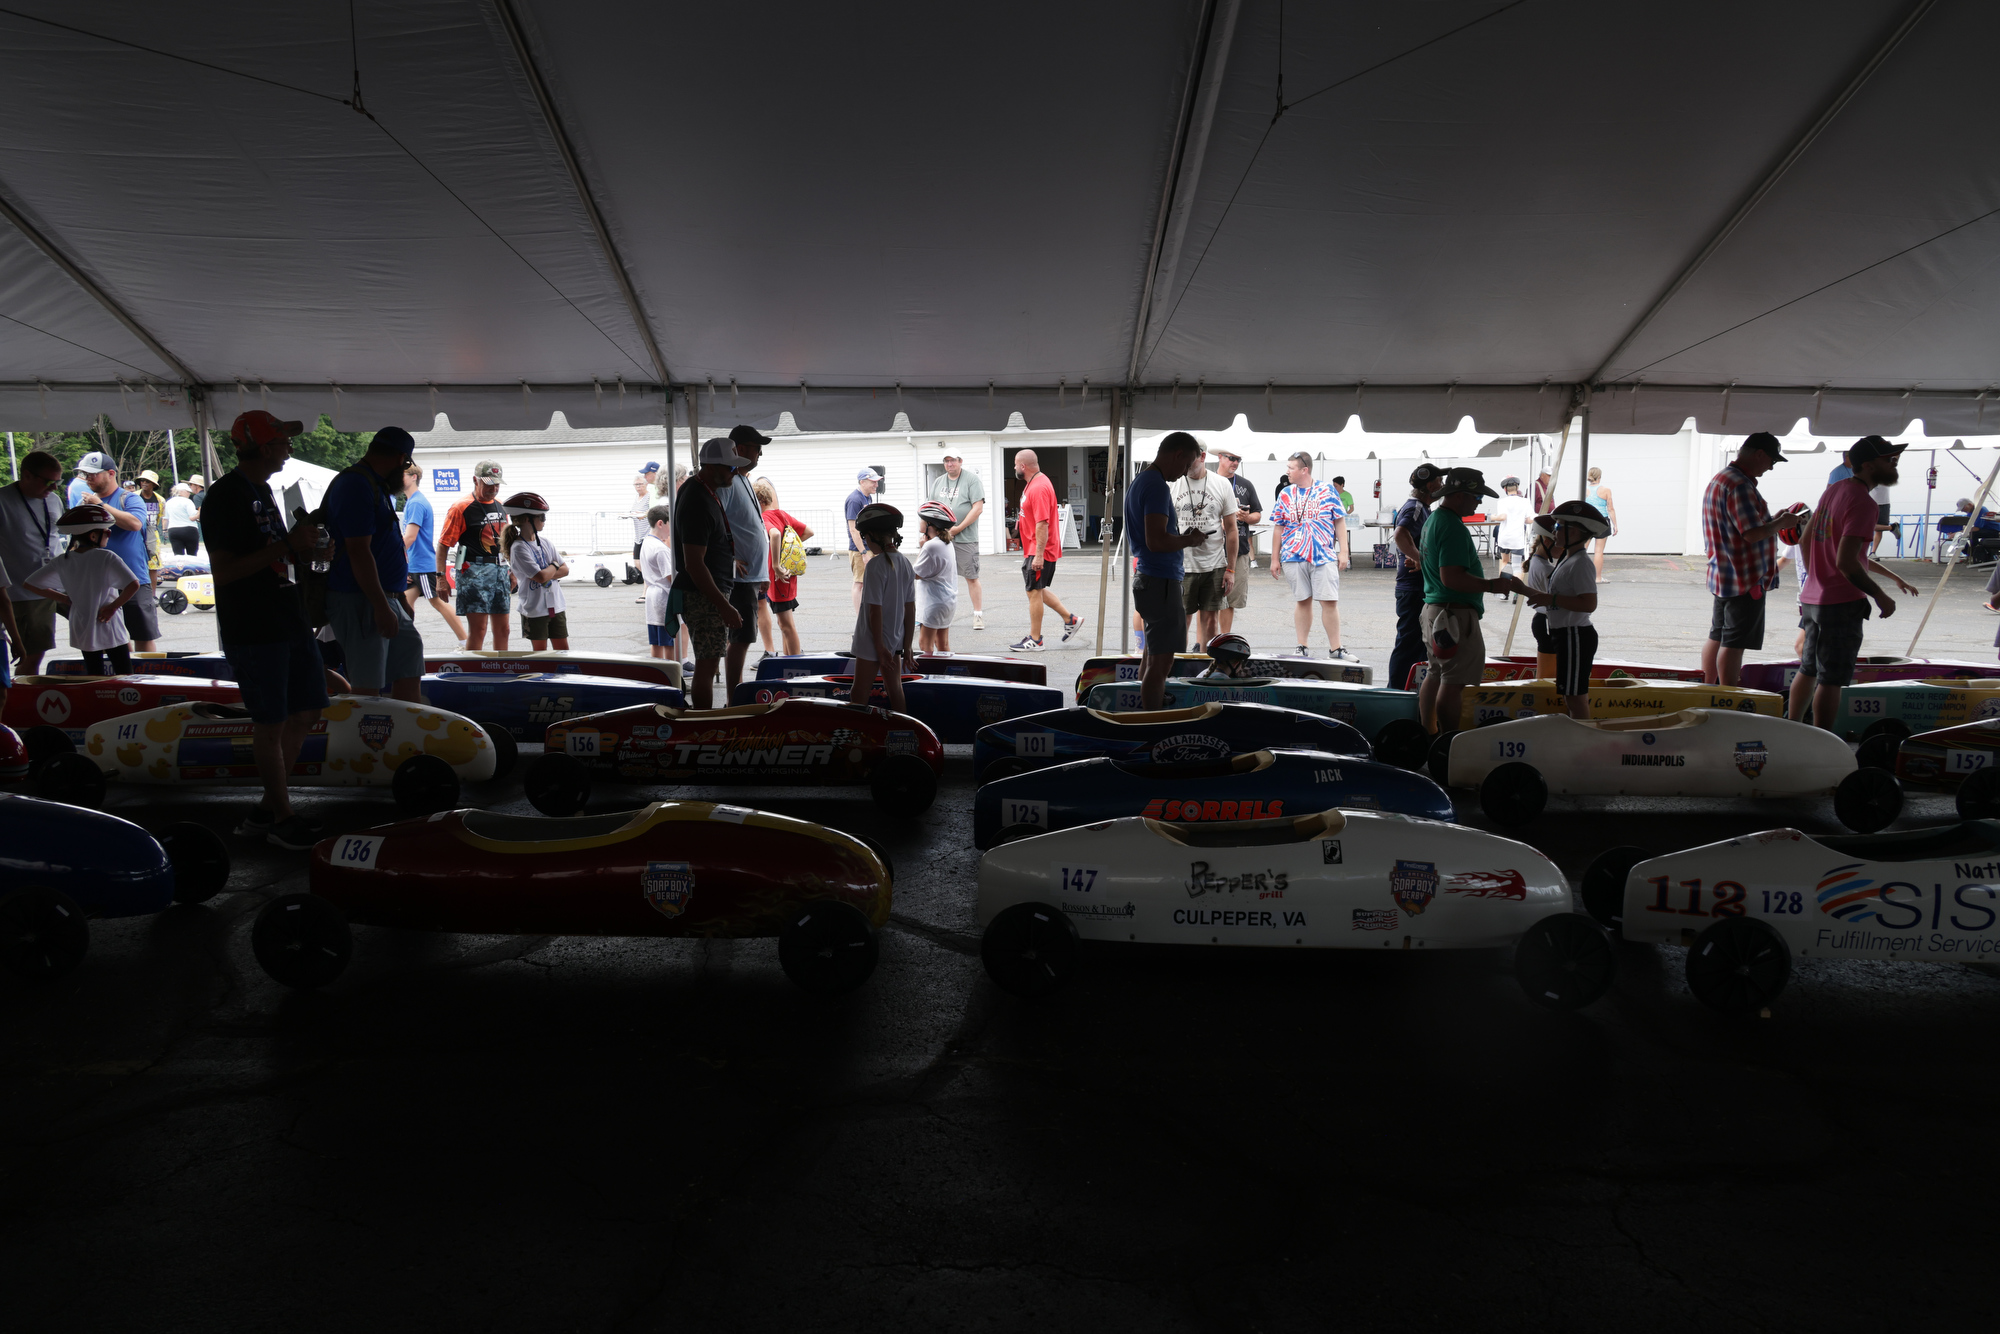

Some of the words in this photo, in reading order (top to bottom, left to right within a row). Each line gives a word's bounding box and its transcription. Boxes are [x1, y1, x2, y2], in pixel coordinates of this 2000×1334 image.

[187, 582, 198, 590] 700
[481, 662, 500, 670] Keith
[502, 662, 530, 671] Carlton
[120, 692, 139, 702] 102
[467, 685, 495, 693] HUNTER
[530, 696, 575, 711] J&S
[1120, 693, 1143, 709] 332
[1473, 691, 1516, 705] 321
[1608, 699, 1665, 708] MARSHALL
[1711, 695, 1733, 707] Leo
[1853, 700, 1881, 713] 333
[1905, 692, 1925, 700] 2024
[118, 724, 138, 739] 141
[187, 726, 249, 735] WILLIAMSPORT
[361, 725, 377, 735] SOAP
[377, 726, 390, 736] BOX
[572, 736, 594, 752] 156
[889, 743, 903, 752] SOAP
[904, 743, 916, 752] BOX
[1023, 737, 1046, 753] 101
[1155, 735, 1230, 755] TALLAHASSEE
[1498, 741, 1526, 758] 139
[1173, 746, 1210, 760] Ford
[1955, 753, 1985, 770] 152
[697, 767, 758, 776] ROANOKE,
[761, 767, 812, 775] VIRGINIA
[1314, 768, 1343, 784] JACK
[1011, 803, 1039, 824] 125
[1166, 799, 1285, 822] SORRELS
[340, 838, 371, 863] 136
[1954, 863, 2000, 879] Nat
[647, 880, 670, 894] SOAP
[670, 880, 689, 894] BOX
[1062, 867, 1099, 892] 147
[1393, 877, 1416, 892] SOAP
[1416, 879, 1435, 895] BOX
[656, 891, 680, 900] DERBY
[1259, 891, 1284, 900] grill
[1401, 890, 1425, 900] DERBY
[1645, 875, 1748, 918] 112
[1762, 890, 1803, 915] 128
[1876, 882, 1996, 931] SIS
[1091, 905, 1099, 913] &
[1173, 909, 1277, 929] CULPEPER,
[1283, 911, 1306, 926] VA
[1816, 928, 1923, 952] Fulfillment
